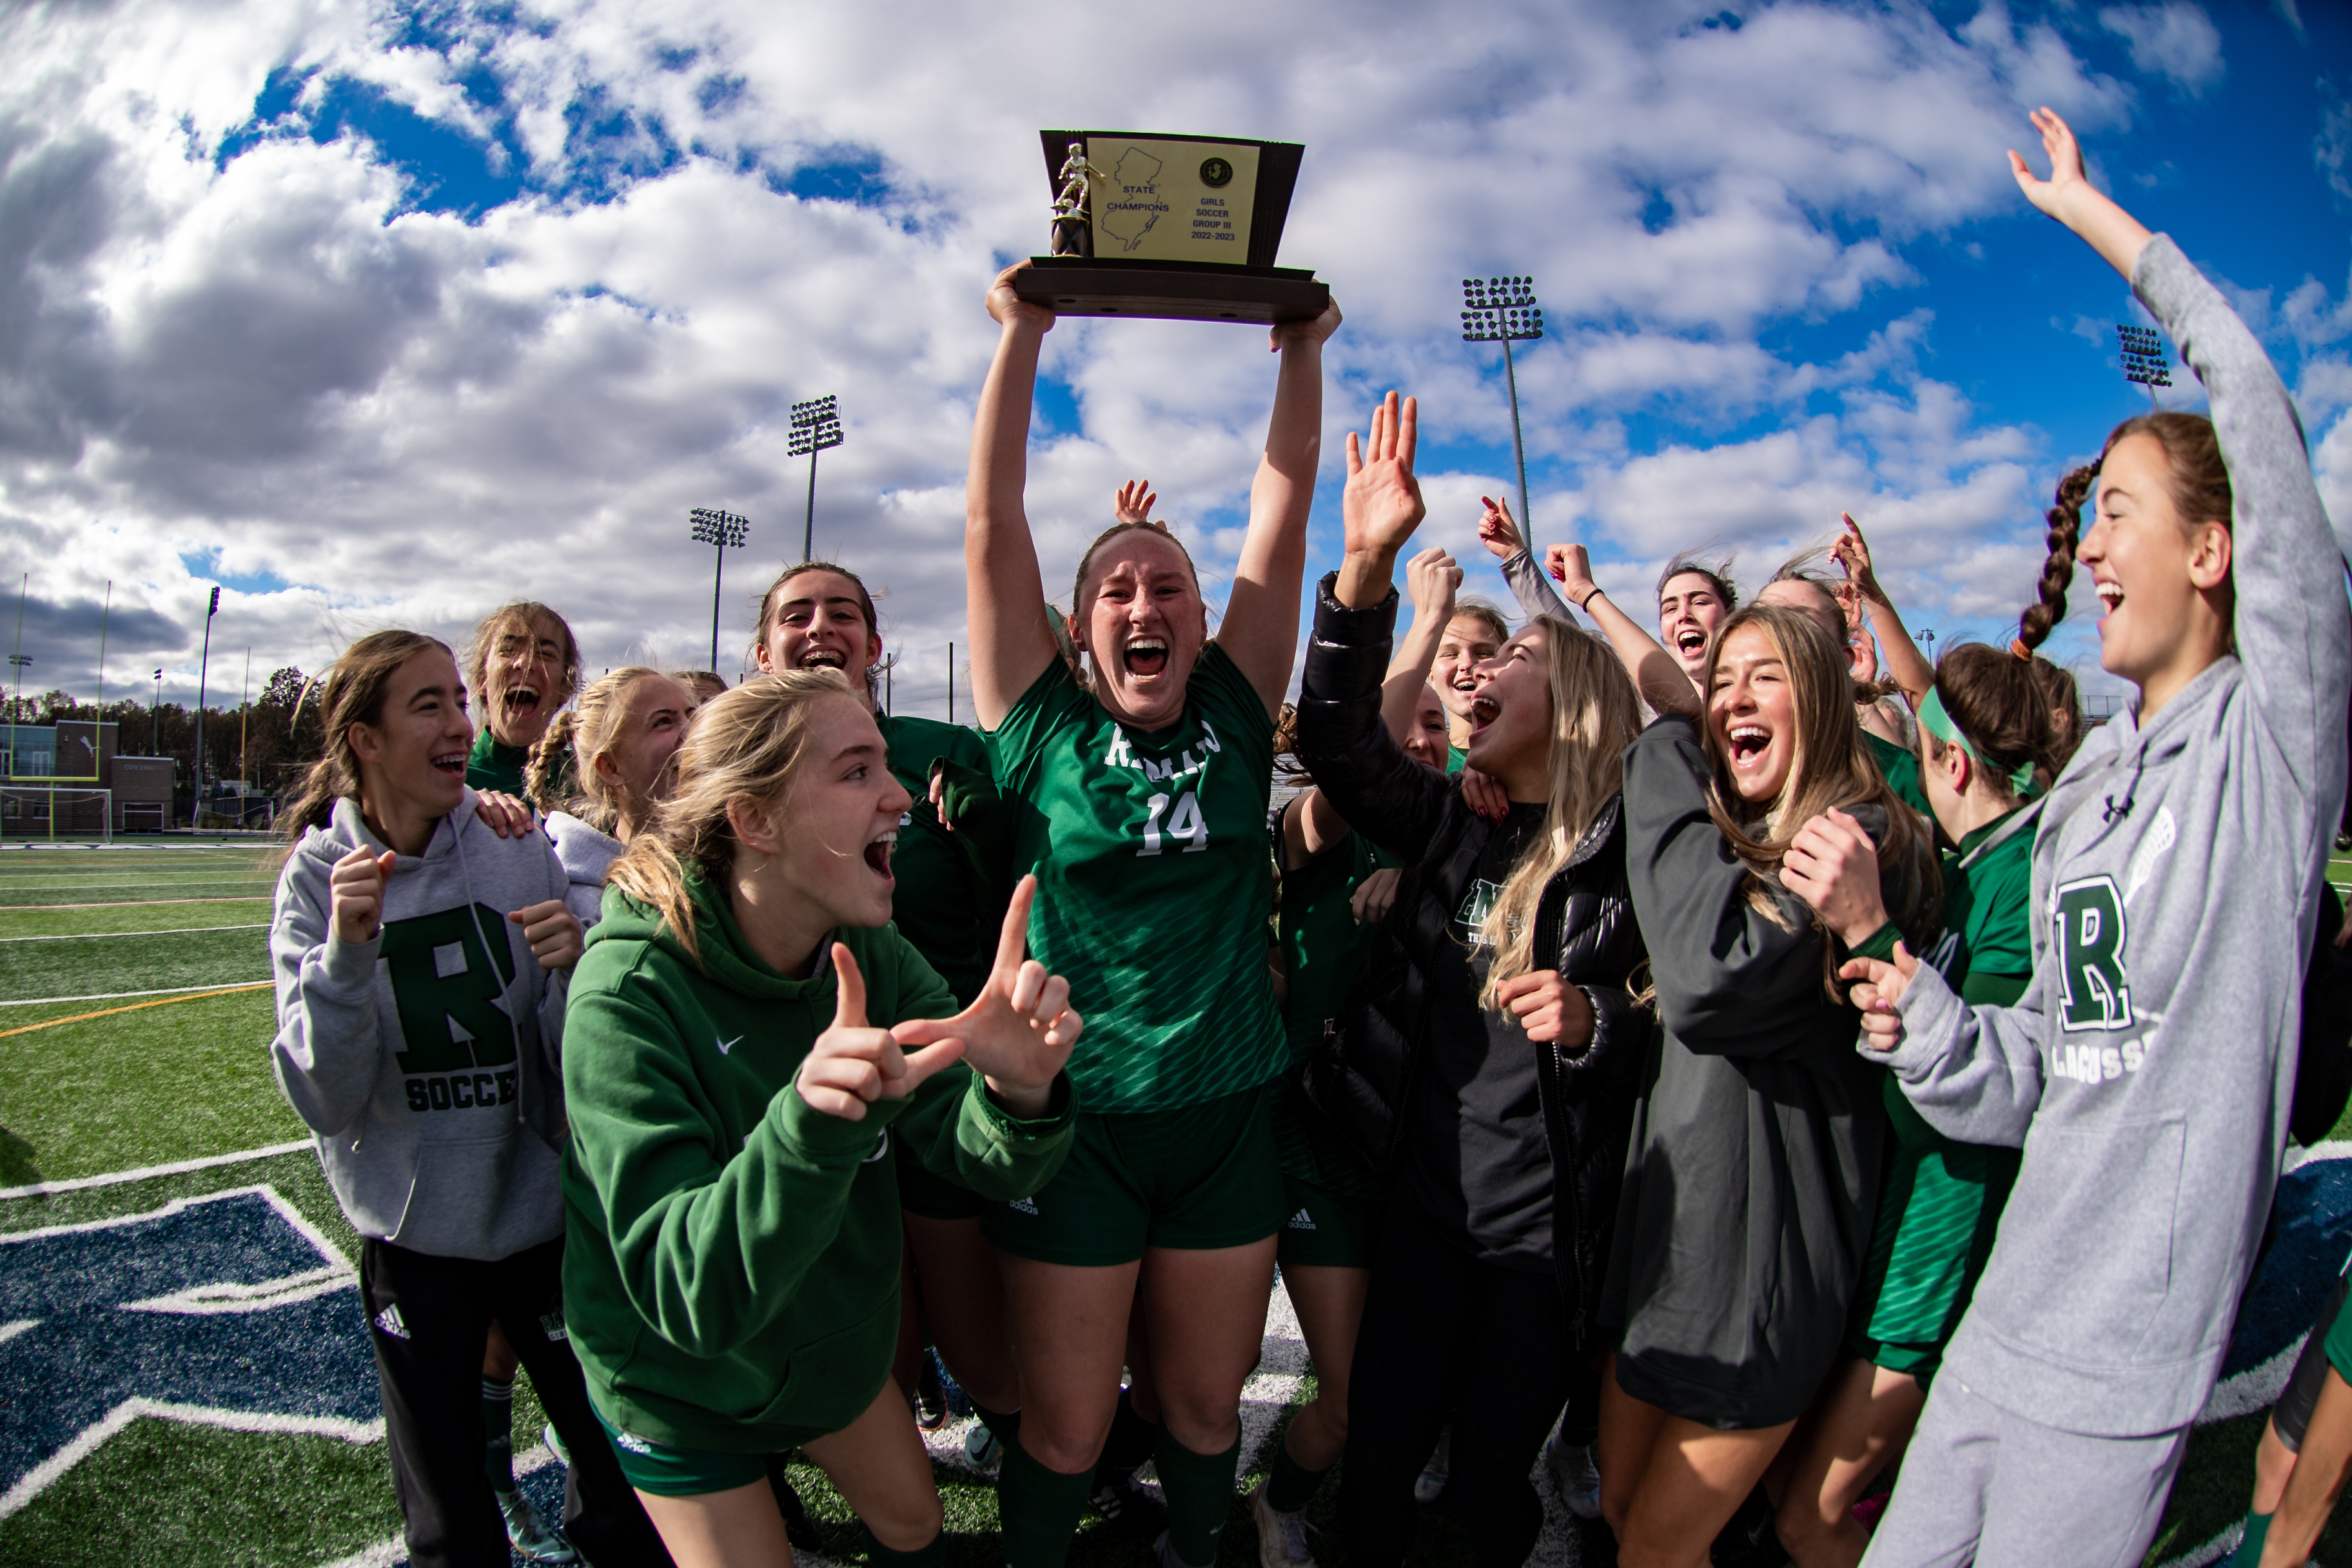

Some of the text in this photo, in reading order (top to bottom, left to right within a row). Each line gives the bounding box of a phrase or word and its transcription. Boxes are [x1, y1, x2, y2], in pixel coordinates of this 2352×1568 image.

[1123, 186, 1155, 194] STATE
[1106, 202, 1170, 211] CHAMPIONS
[1200, 198, 1225, 206] GIRLS
[1196, 209, 1229, 218] SOCCER
[1193, 220, 1231, 230] GROUP III
[1191, 231, 1235, 241] 2022-2023
[1136, 792, 1210, 857] 14
[2055, 874, 2135, 1034] R
[378, 901, 516, 1074] R
[405, 1069, 516, 1112] SOCCE
[1010, 1200, 1038, 1215] adidas
[1288, 1221, 1316, 1230] adidas
[375, 1317, 411, 1339] adidas
